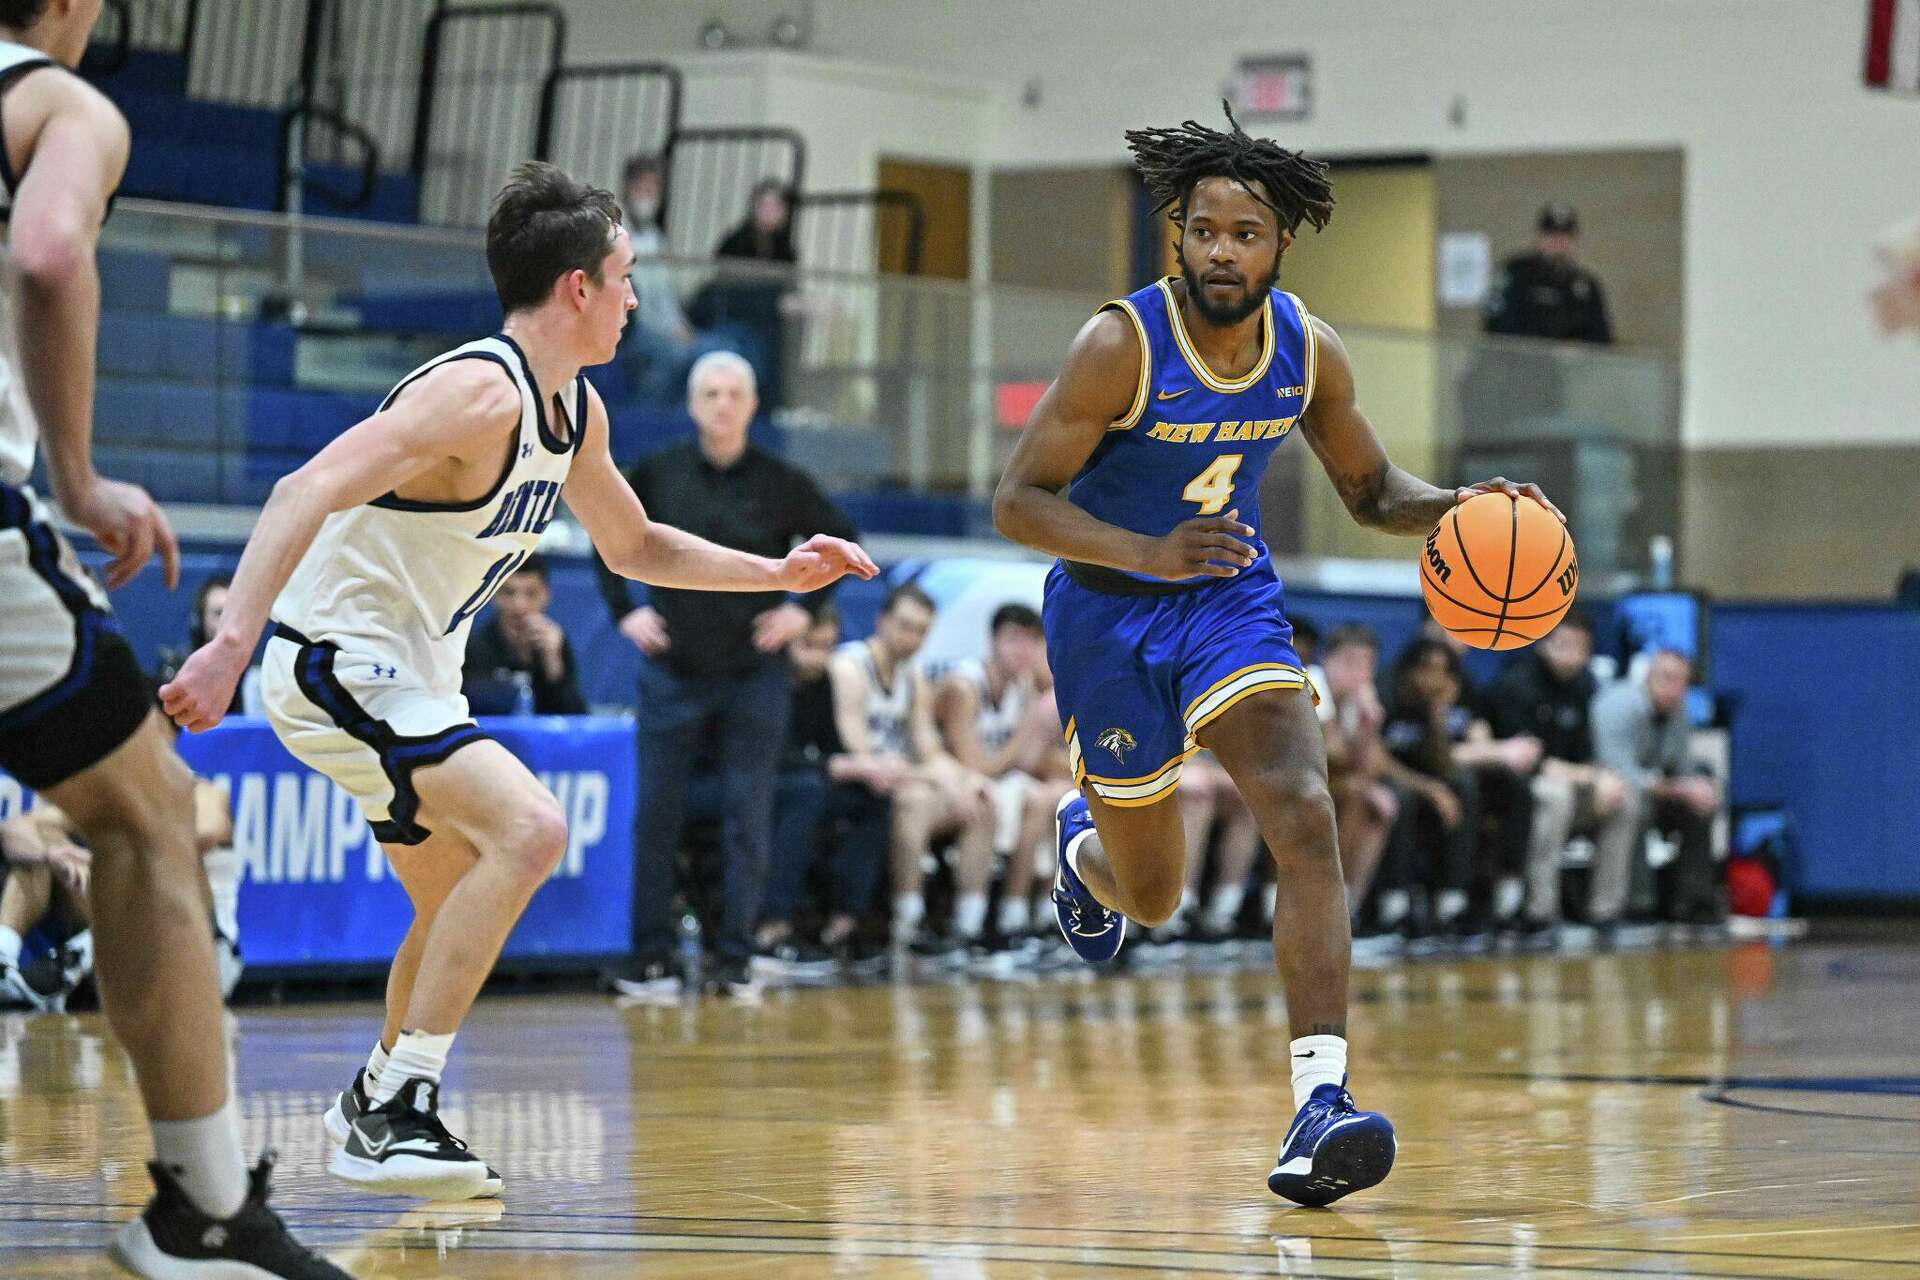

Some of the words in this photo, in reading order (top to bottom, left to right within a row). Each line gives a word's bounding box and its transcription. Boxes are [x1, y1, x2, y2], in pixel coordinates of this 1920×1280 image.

[1146, 421, 1217, 444] NEW
[1214, 415, 1298, 442] HAVEN
[475, 479, 565, 539] BENTL
[1181, 453, 1244, 516] 4
